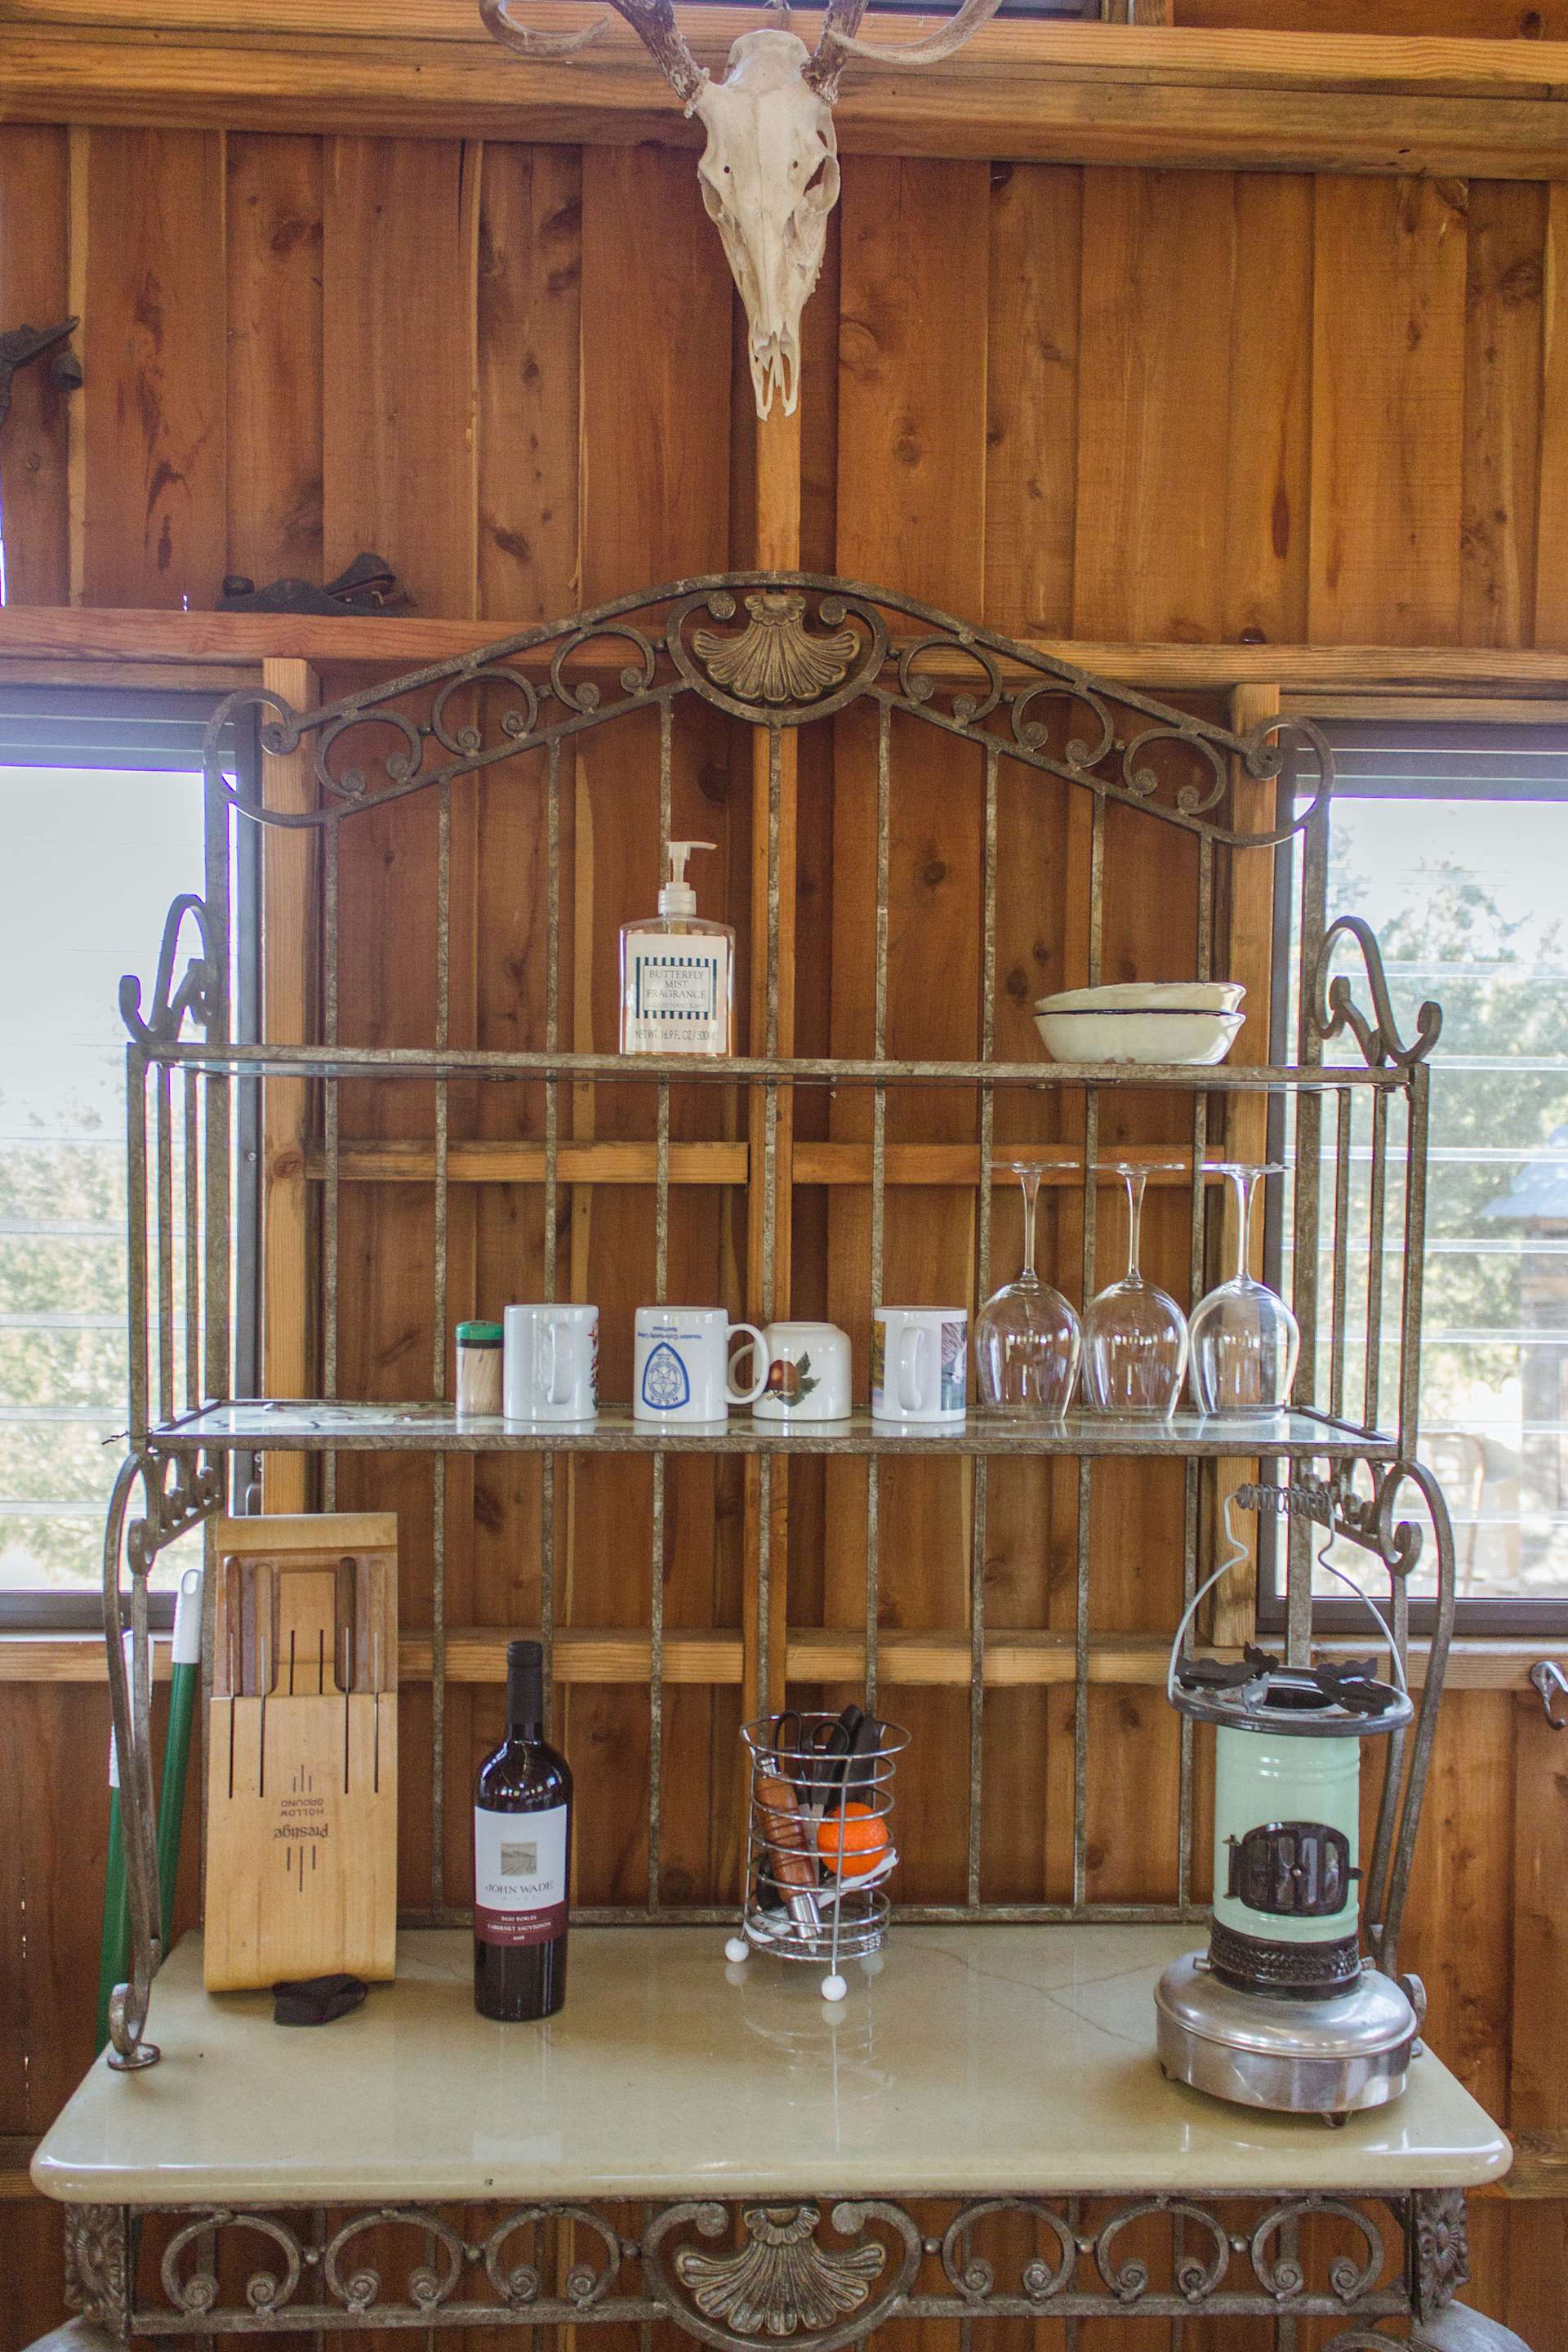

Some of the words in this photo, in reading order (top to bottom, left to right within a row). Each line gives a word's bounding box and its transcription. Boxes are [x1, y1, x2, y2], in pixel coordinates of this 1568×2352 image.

[649, 969, 704, 979] BUTTERFLY
[665, 979, 688, 989] MIST
[647, 989, 706, 999] FRAGRANCE
[281, 1797, 325, 1807] GROUND
[281, 1808, 325, 1817] HOLLOW
[485, 1883, 517, 1894] JOHN
[519, 1881, 554, 1894] WADE
